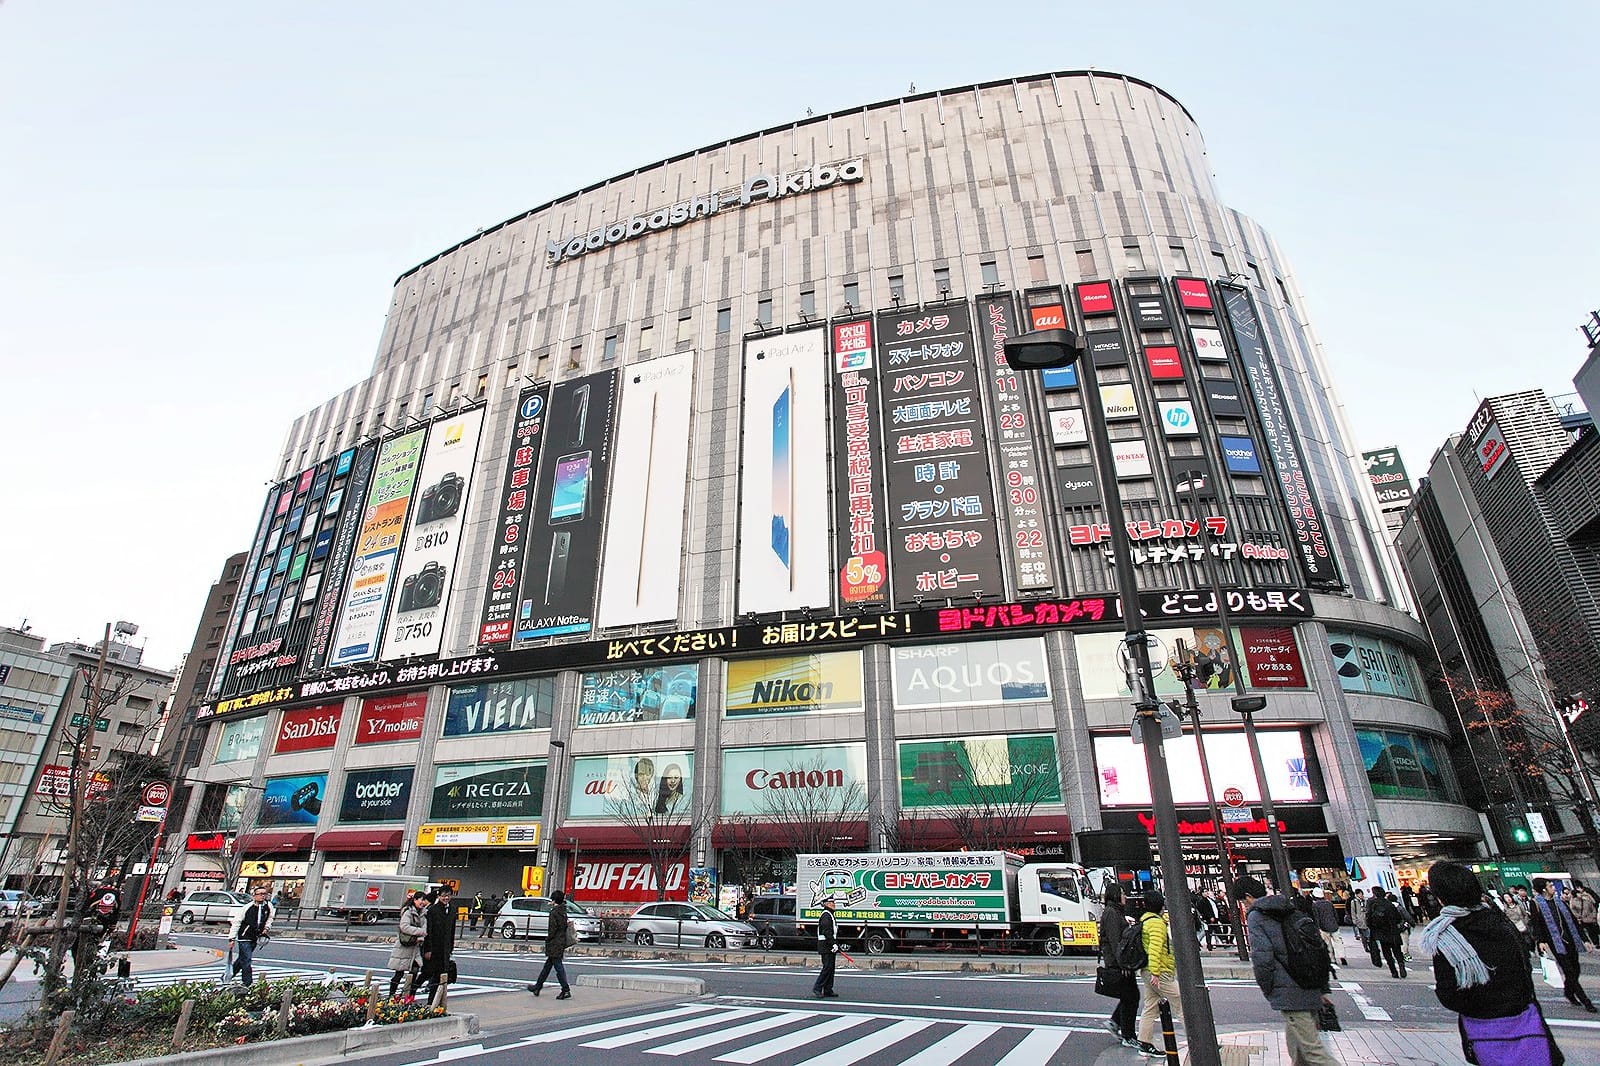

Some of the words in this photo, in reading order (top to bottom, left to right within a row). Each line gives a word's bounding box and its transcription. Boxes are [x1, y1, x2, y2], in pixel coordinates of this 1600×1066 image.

[547, 157, 864, 262] Yodobashi-Akiba
[1083, 294, 1108, 302] docomo
[896, 315, 950, 336] カメラ
[1035, 315, 1062, 327] au
[840, 324, 866, 339] 欢迎
[768, 346, 790, 358] iPad
[791, 345, 806, 353] Air
[1210, 340, 1223, 348] LG
[889, 341, 964, 366] スマートフォン
[642, 368, 664, 383] iPad
[893, 370, 964, 393] パソコン
[996, 376, 1018, 392] 11
[526, 399, 539, 417] P
[892, 396, 972, 424] 大画面テレビ
[1106, 405, 1134, 414] Nikon
[1000, 412, 1025, 430] 23
[1170, 410, 1190, 427] hp
[444, 437, 460, 448] Nikon
[898, 428, 974, 454] 生活家電
[1116, 453, 1145, 461] PENTAX
[1226, 449, 1253, 457] brother
[506, 446, 534, 511] 駐車場
[914, 460, 960, 482] 時計
[1065, 480, 1094, 490] dyson
[378, 490, 402, 502] センター
[1010, 486, 1037, 506] 30
[901, 495, 983, 522] ブランド品
[364, 515, 402, 534] レストラン街
[504, 524, 520, 544] 8
[904, 530, 983, 552] おもちゃ
[1016, 530, 1043, 548] 22
[1242, 543, 1290, 560] Akiba
[498, 559, 516, 570] よる
[846, 557, 882, 584] 5%
[492, 569, 516, 590] 24
[916, 568, 980, 592] ホビー
[520, 616, 557, 631] GALAXY
[556, 615, 580, 626] Note
[395, 621, 432, 644] D750
[606, 630, 738, 660] 比べてください！
[762, 614, 912, 645] お届けスピード！
[898, 647, 960, 660] SHARP
[1249, 646, 1290, 654] カケホーダイ
[1270, 654, 1276, 662] &
[584, 671, 648, 689] ニッポンを、
[907, 661, 1035, 694] AQUOS
[451, 686, 478, 695] Panasonic
[582, 690, 630, 705] 超速へ。
[751, 679, 834, 704] Nikon
[580, 712, 626, 725] WiMAX
[626, 708, 644, 722] 2+
[282, 716, 340, 740] SanDisk
[366, 718, 418, 734] Y!mobile
[1024, 764, 1049, 775] ONE
[584, 779, 618, 795] au
[745, 768, 844, 790] Canon
[356, 780, 404, 798] brother
[447, 786, 462, 798] 4K
[466, 782, 532, 798] REGZA
[367, 800, 380, 808] your
[380, 798, 392, 806] side
[884, 872, 992, 889] ヨドバシカメラ
[895, 898, 976, 907] www.yodobashi.com
